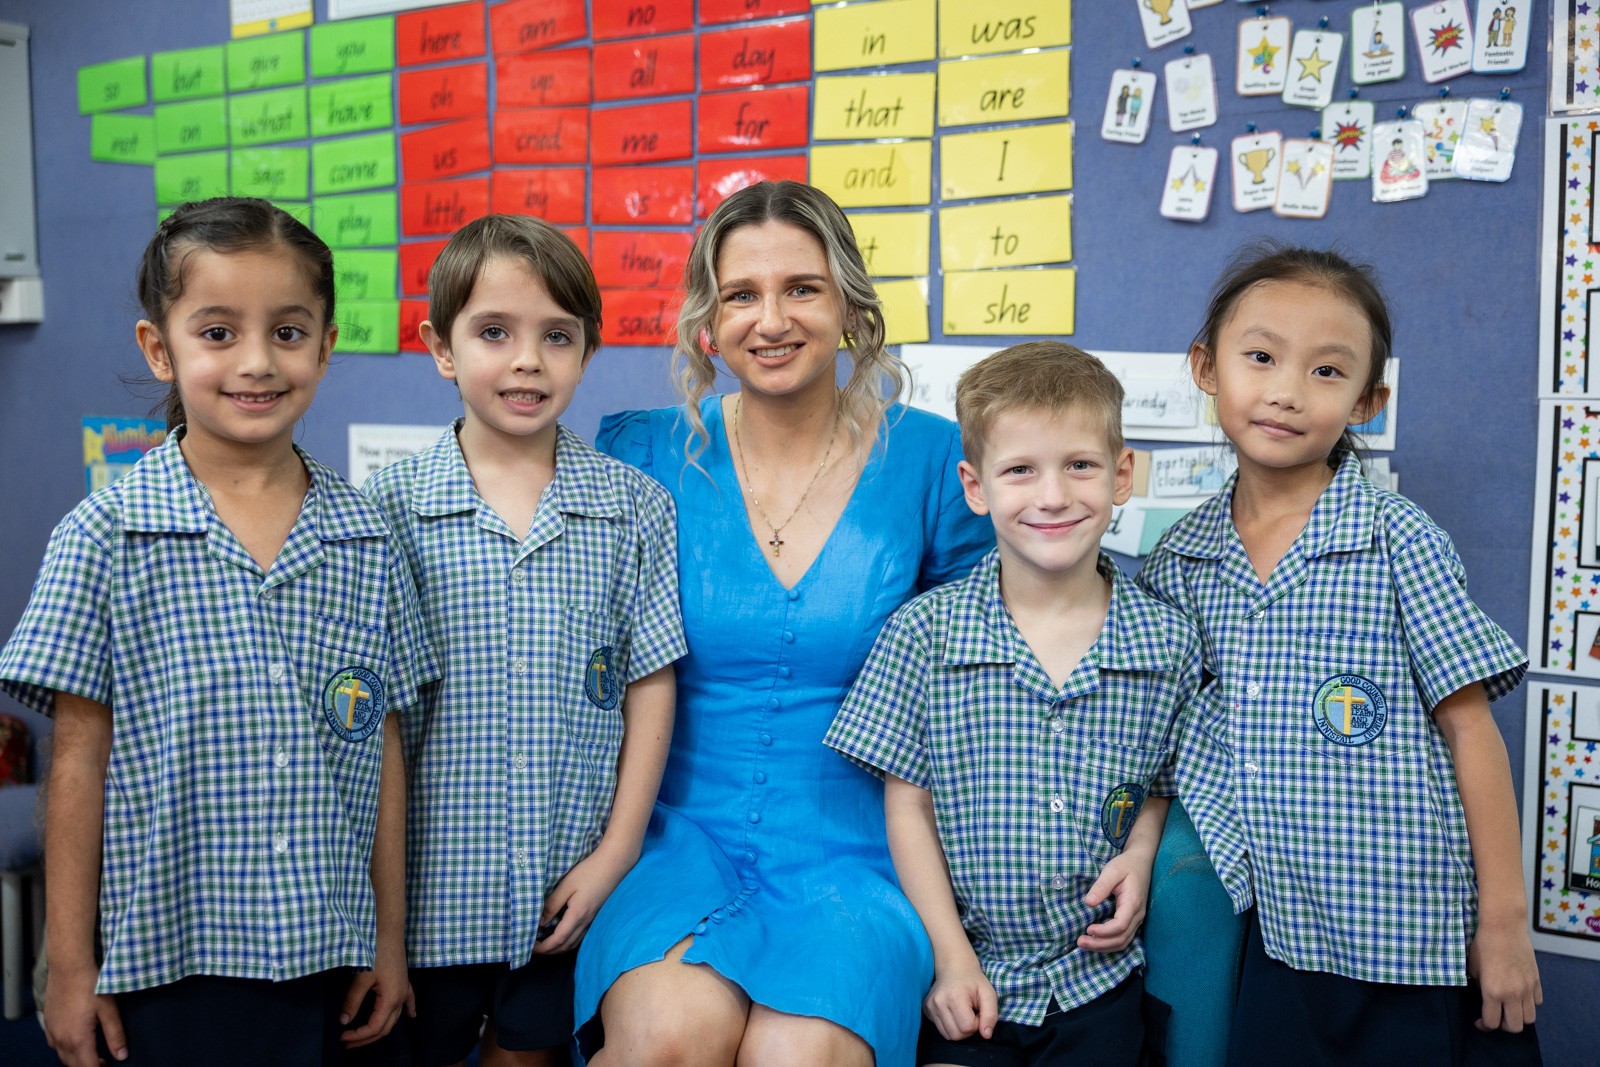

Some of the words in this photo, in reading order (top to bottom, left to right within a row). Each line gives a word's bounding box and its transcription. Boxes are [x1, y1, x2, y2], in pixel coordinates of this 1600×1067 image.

[518, 16, 556, 41] am
[627, 5, 657, 28] no
[970, 15, 1036, 44] was
[420, 22, 462, 55] here
[862, 26, 885, 56] in
[337, 41, 366, 74] you
[630, 49, 659, 87] all
[732, 37, 775, 81] day
[173, 60, 203, 93] but
[530, 76, 556, 103] up
[431, 79, 454, 107] oh
[844, 88, 904, 128] that
[979, 86, 1025, 111] are
[243, 102, 294, 136] what
[328, 94, 374, 126] have
[735, 102, 770, 140] for
[111, 133, 138, 155] not
[515, 119, 562, 152] cried
[621, 131, 659, 154] me
[329, 160, 379, 184] come
[433, 146, 457, 170] us
[843, 149, 896, 189] and
[997, 140, 1010, 182] I
[424, 191, 466, 226] little
[525, 180, 549, 217] by
[337, 205, 370, 245] play
[991, 227, 1019, 257] to
[620, 244, 663, 287] they
[617, 302, 665, 338] said
[984, 284, 1031, 325] she
[345, 310, 373, 345] like
[352, 668, 371, 680] GOOD
[1340, 676, 1361, 685] GOOD
[1361, 681, 1385, 712] COUNSEL
[1317, 717, 1354, 744] INNISFAIL
[1363, 713, 1385, 740] PRIMARY
[1585, 876, 1600, 889] Ho
